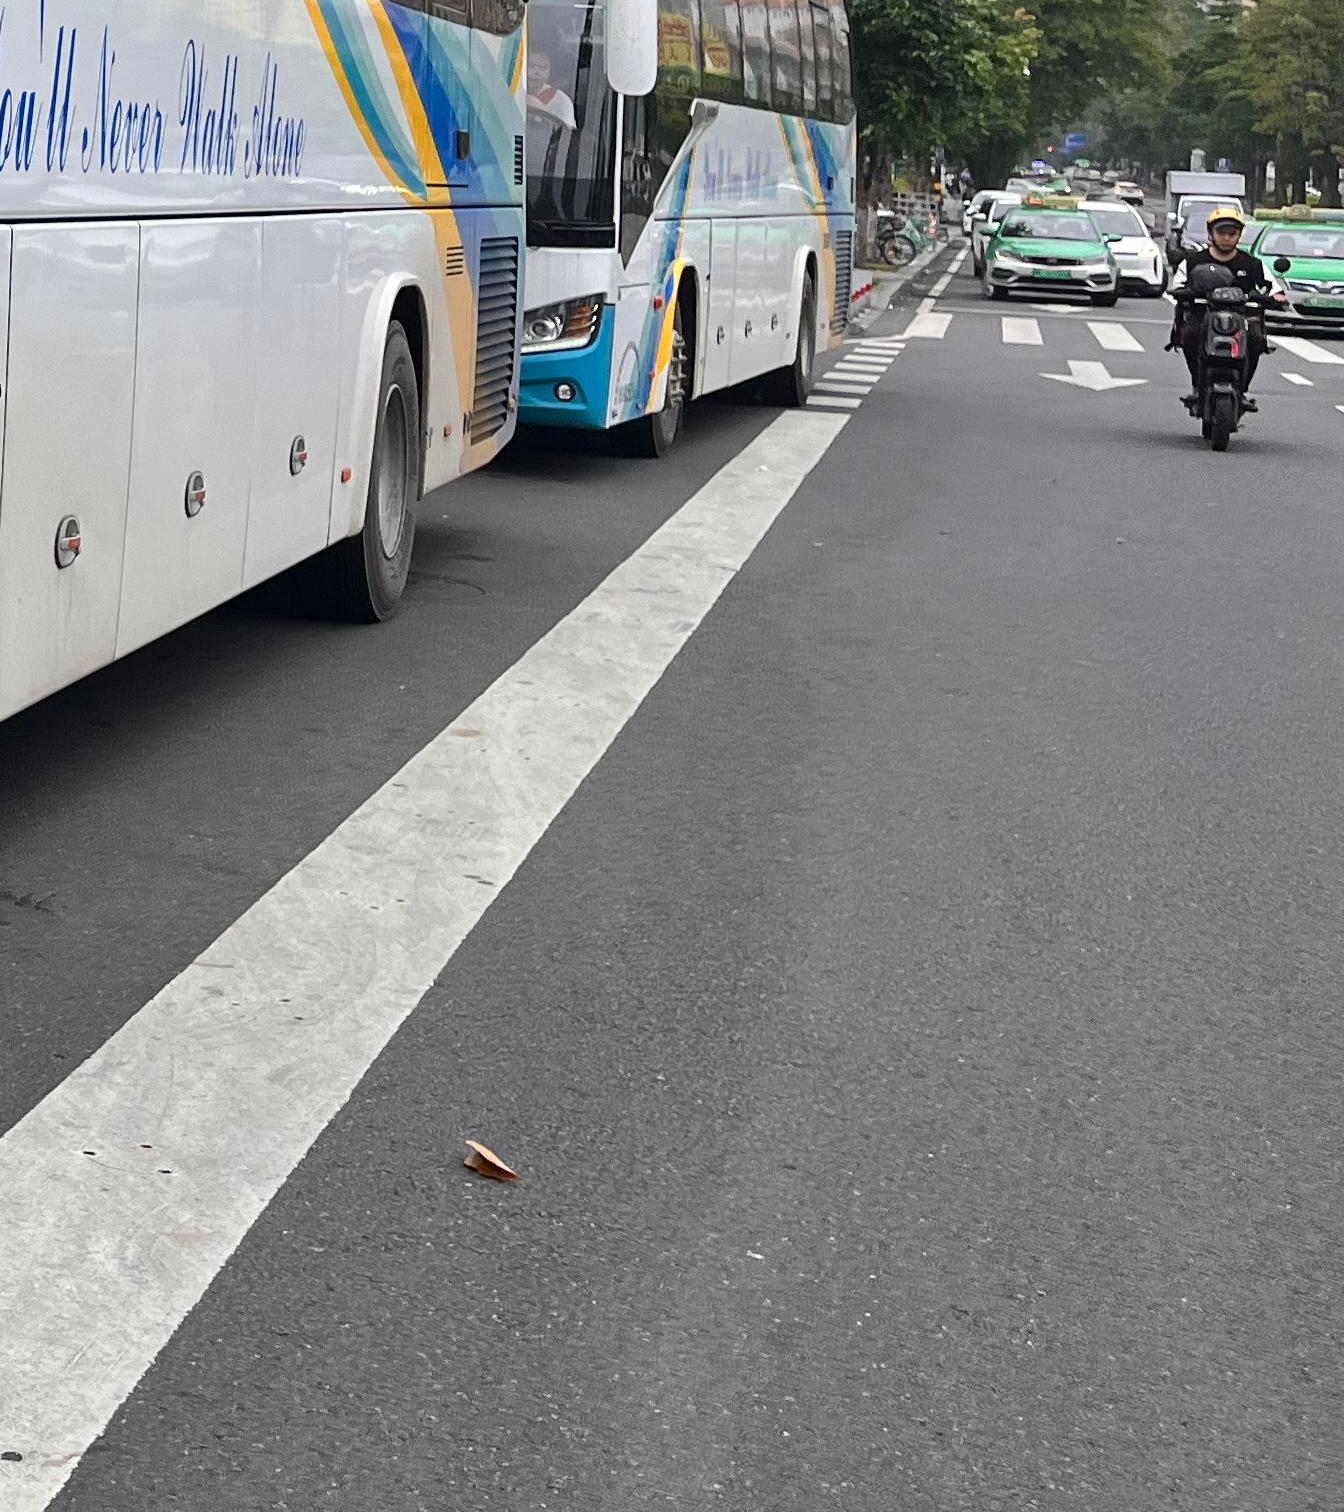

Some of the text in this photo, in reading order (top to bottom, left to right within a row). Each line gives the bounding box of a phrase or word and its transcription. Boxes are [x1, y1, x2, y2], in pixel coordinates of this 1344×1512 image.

[82, 23, 168, 175] Never
[179, 38, 238, 177] Walk
[244, 50, 306, 180] Alone
